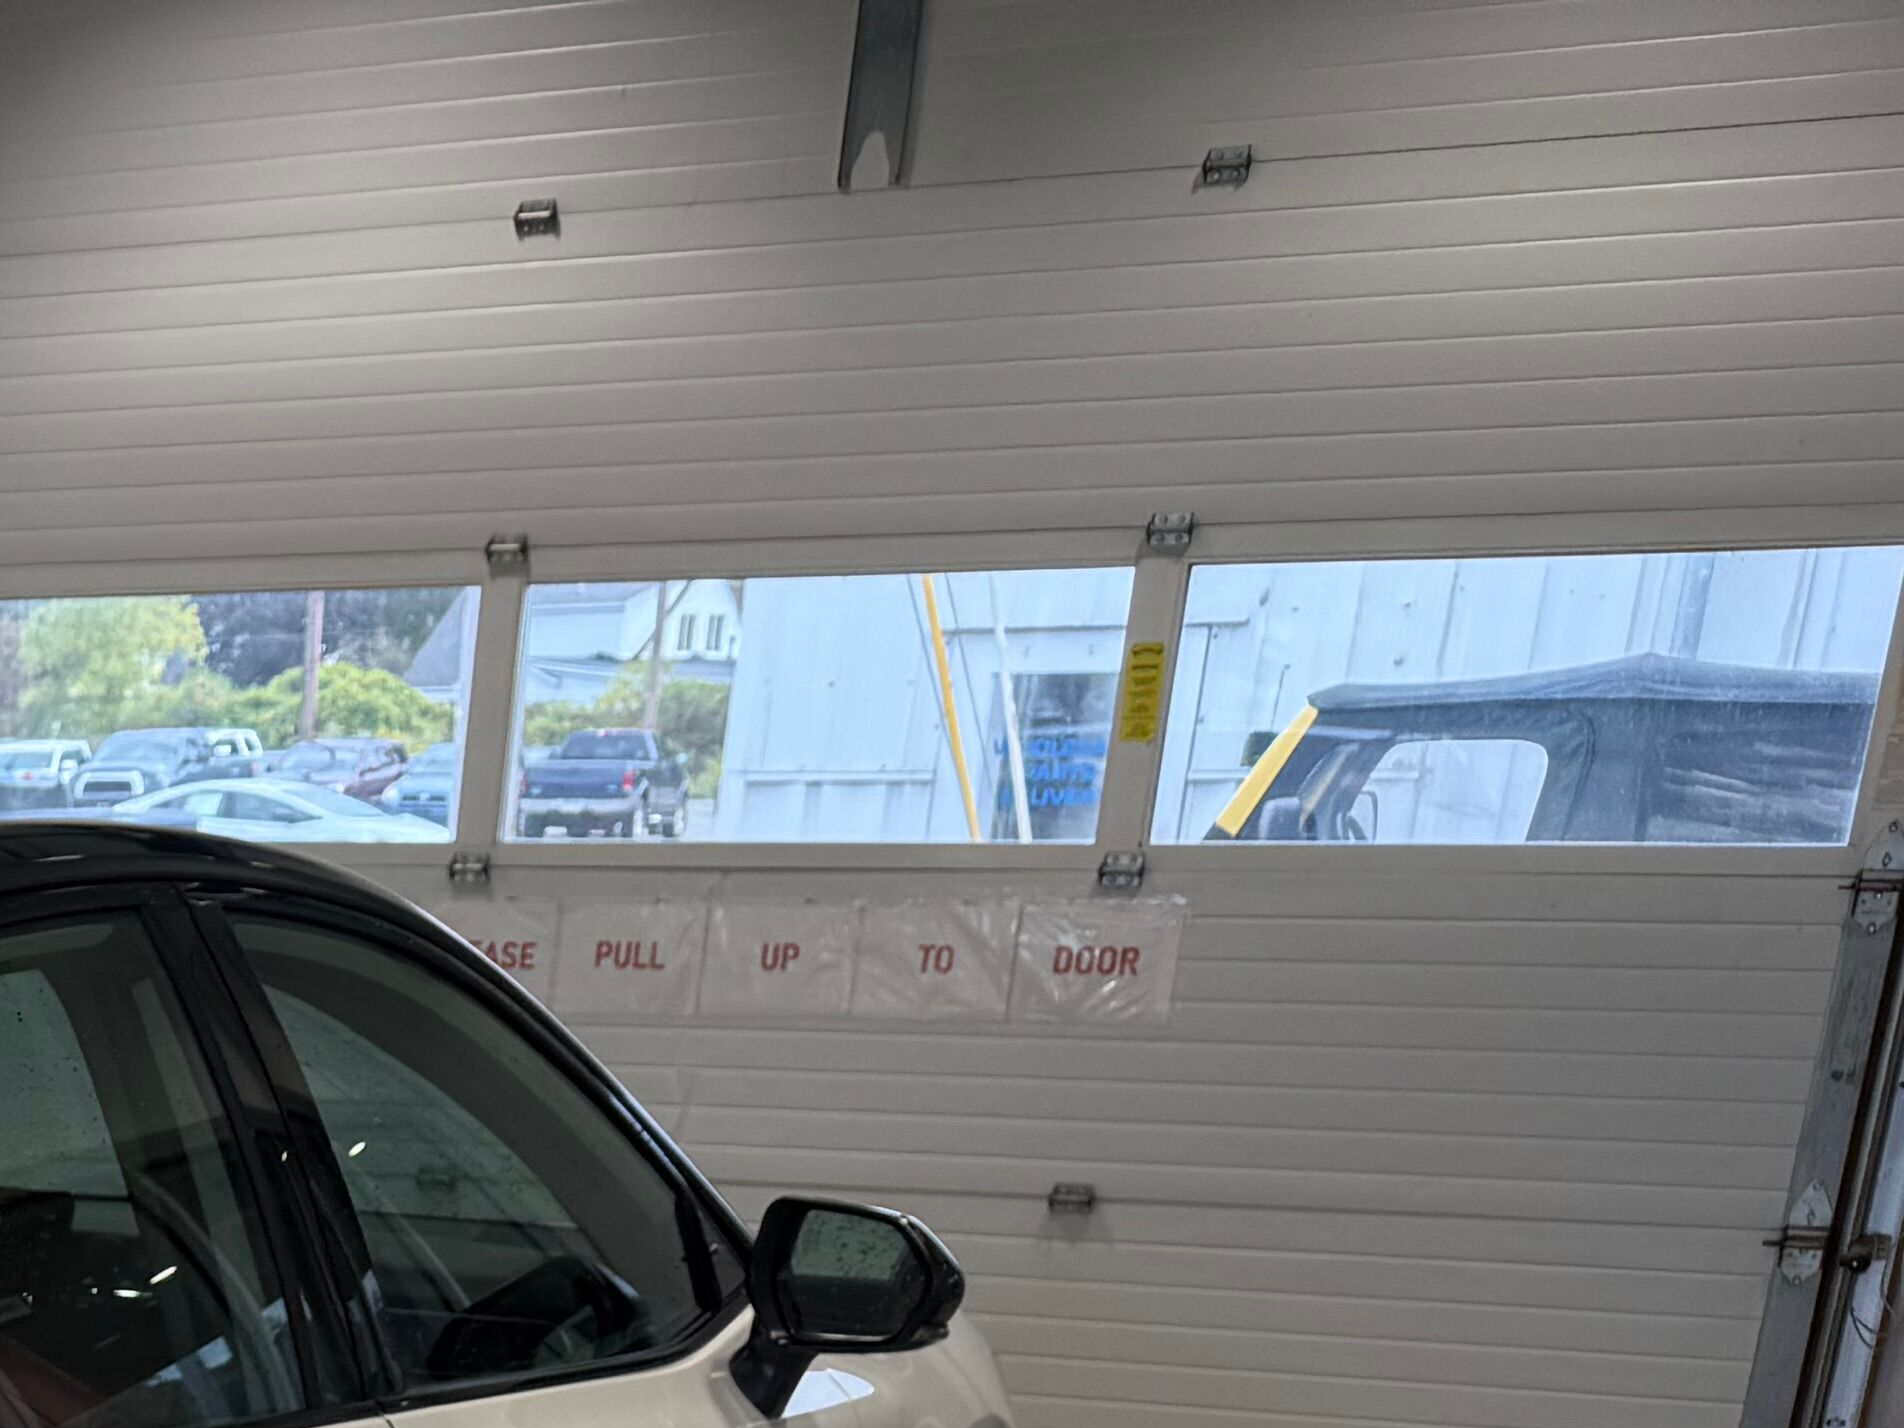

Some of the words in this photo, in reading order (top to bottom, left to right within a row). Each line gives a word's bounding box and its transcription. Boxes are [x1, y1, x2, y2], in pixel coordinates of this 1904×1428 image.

[470, 940, 537, 970] ASE
[594, 941, 665, 970] PULL
[761, 942, 800, 971] UP
[919, 943, 955, 975] TO
[1053, 945, 1140, 977] DOOR
